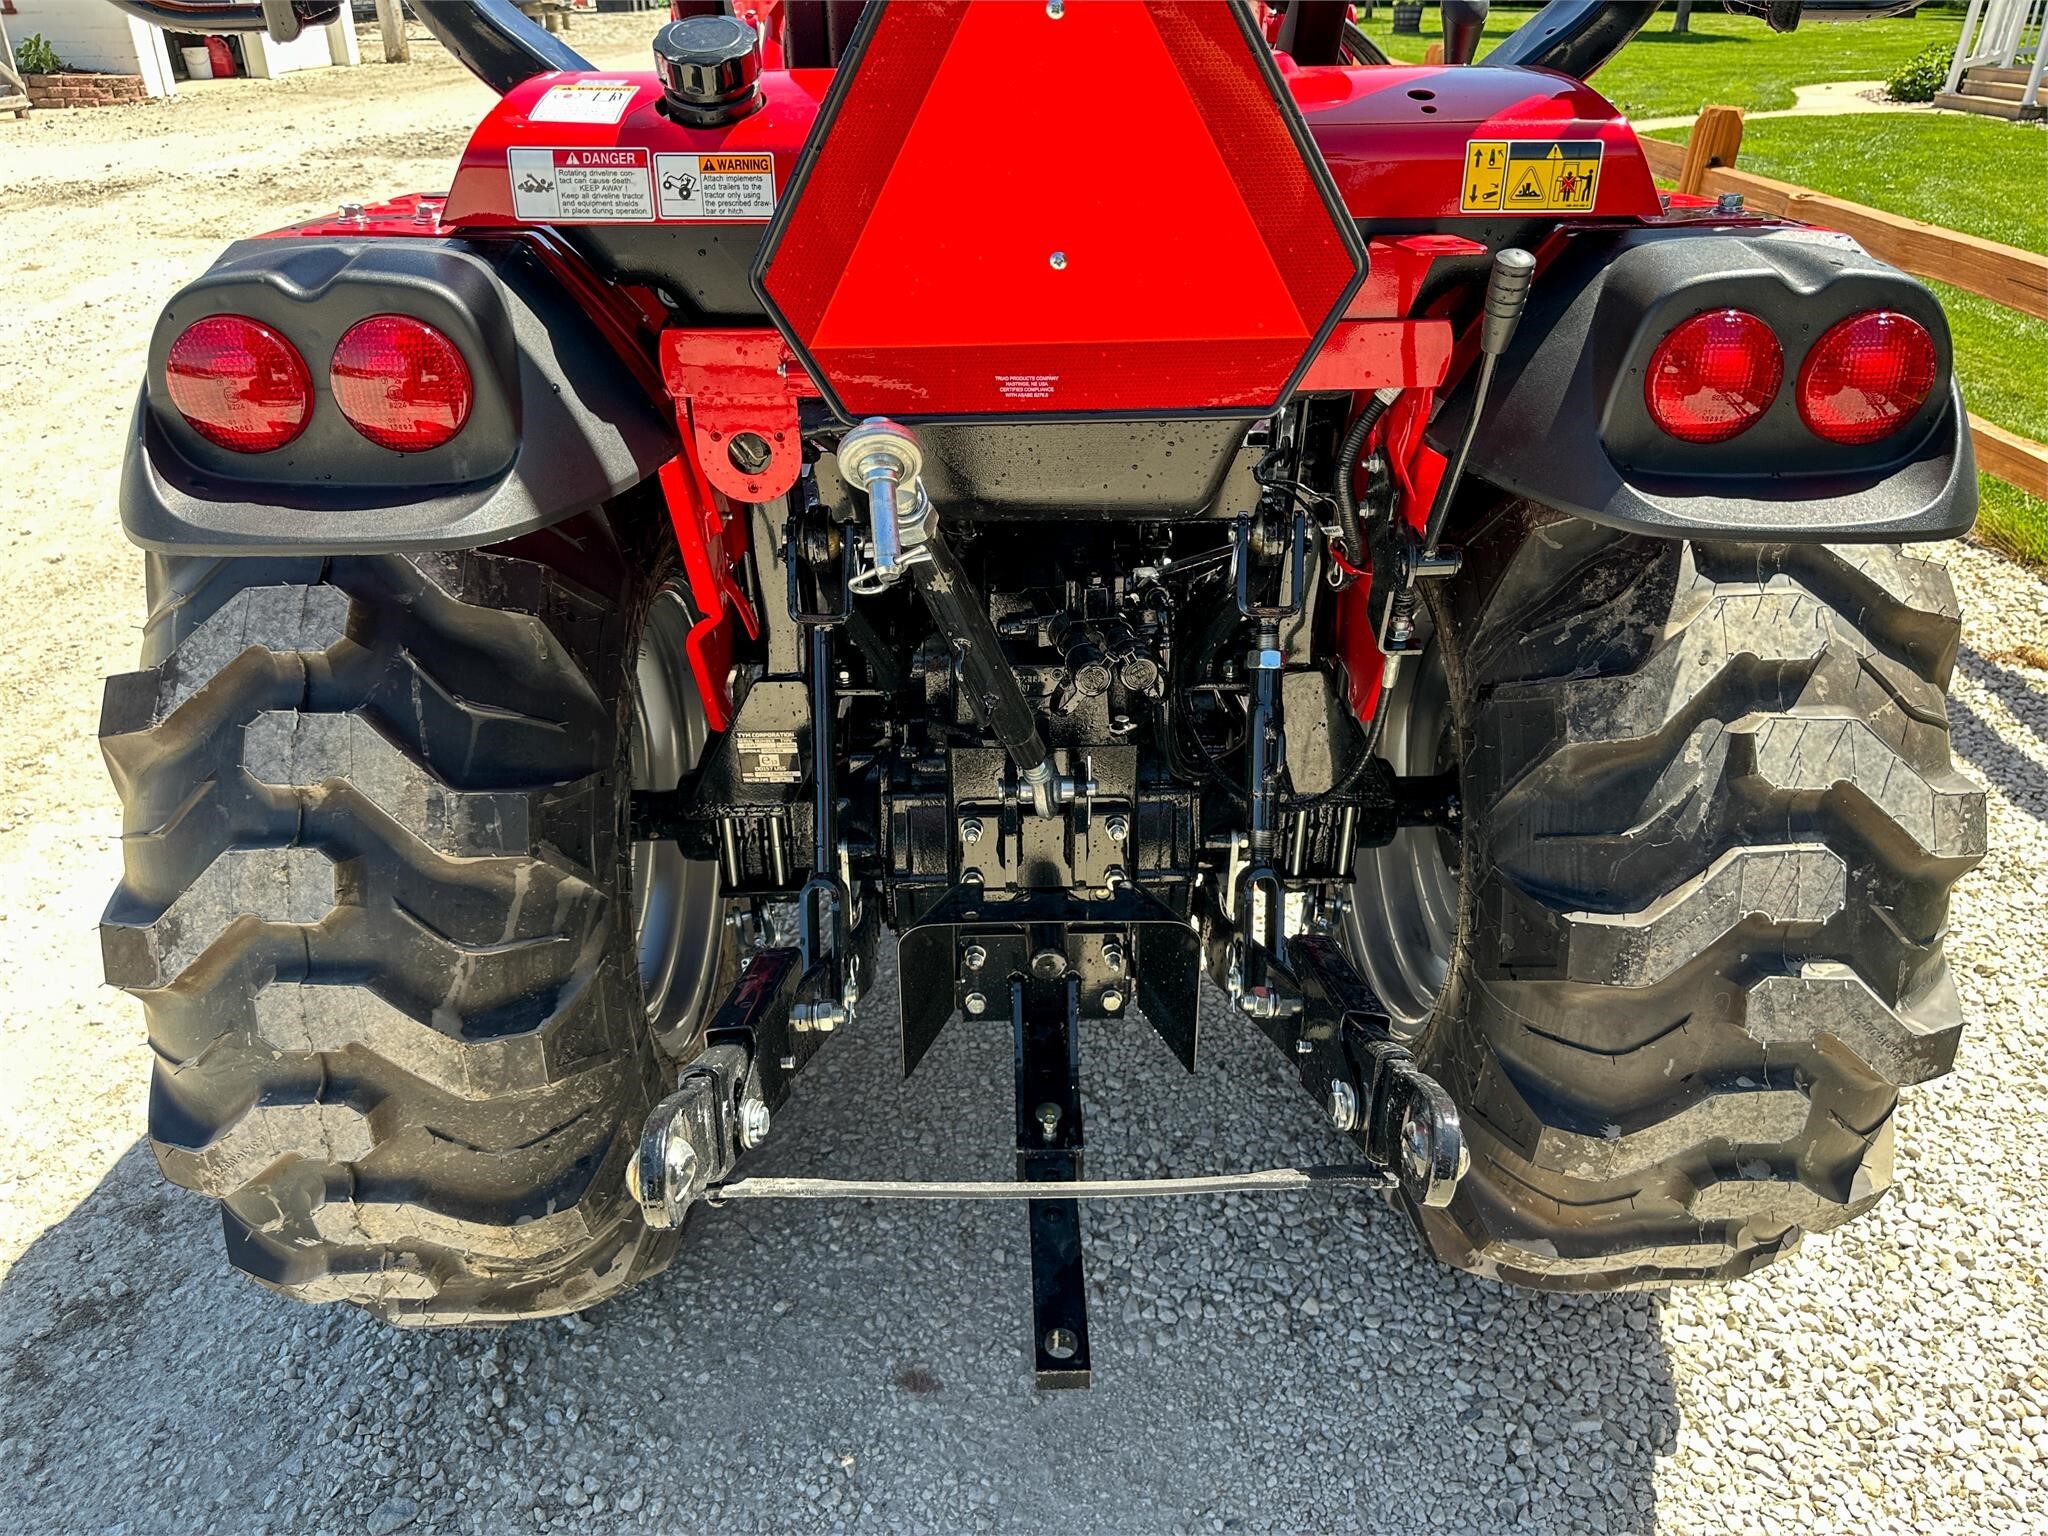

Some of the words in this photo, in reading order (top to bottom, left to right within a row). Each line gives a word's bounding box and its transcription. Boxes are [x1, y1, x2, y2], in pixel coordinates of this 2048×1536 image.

[583, 152, 635, 164] DANGER
[717, 159, 769, 170] WARNING
[558, 169, 587, 177] Rotating
[726, 175, 763, 183] implements
[561, 192, 580, 200] Keep
[727, 192, 741, 200] only
[743, 192, 761, 200] using
[717, 200, 751, 208] prescribed
